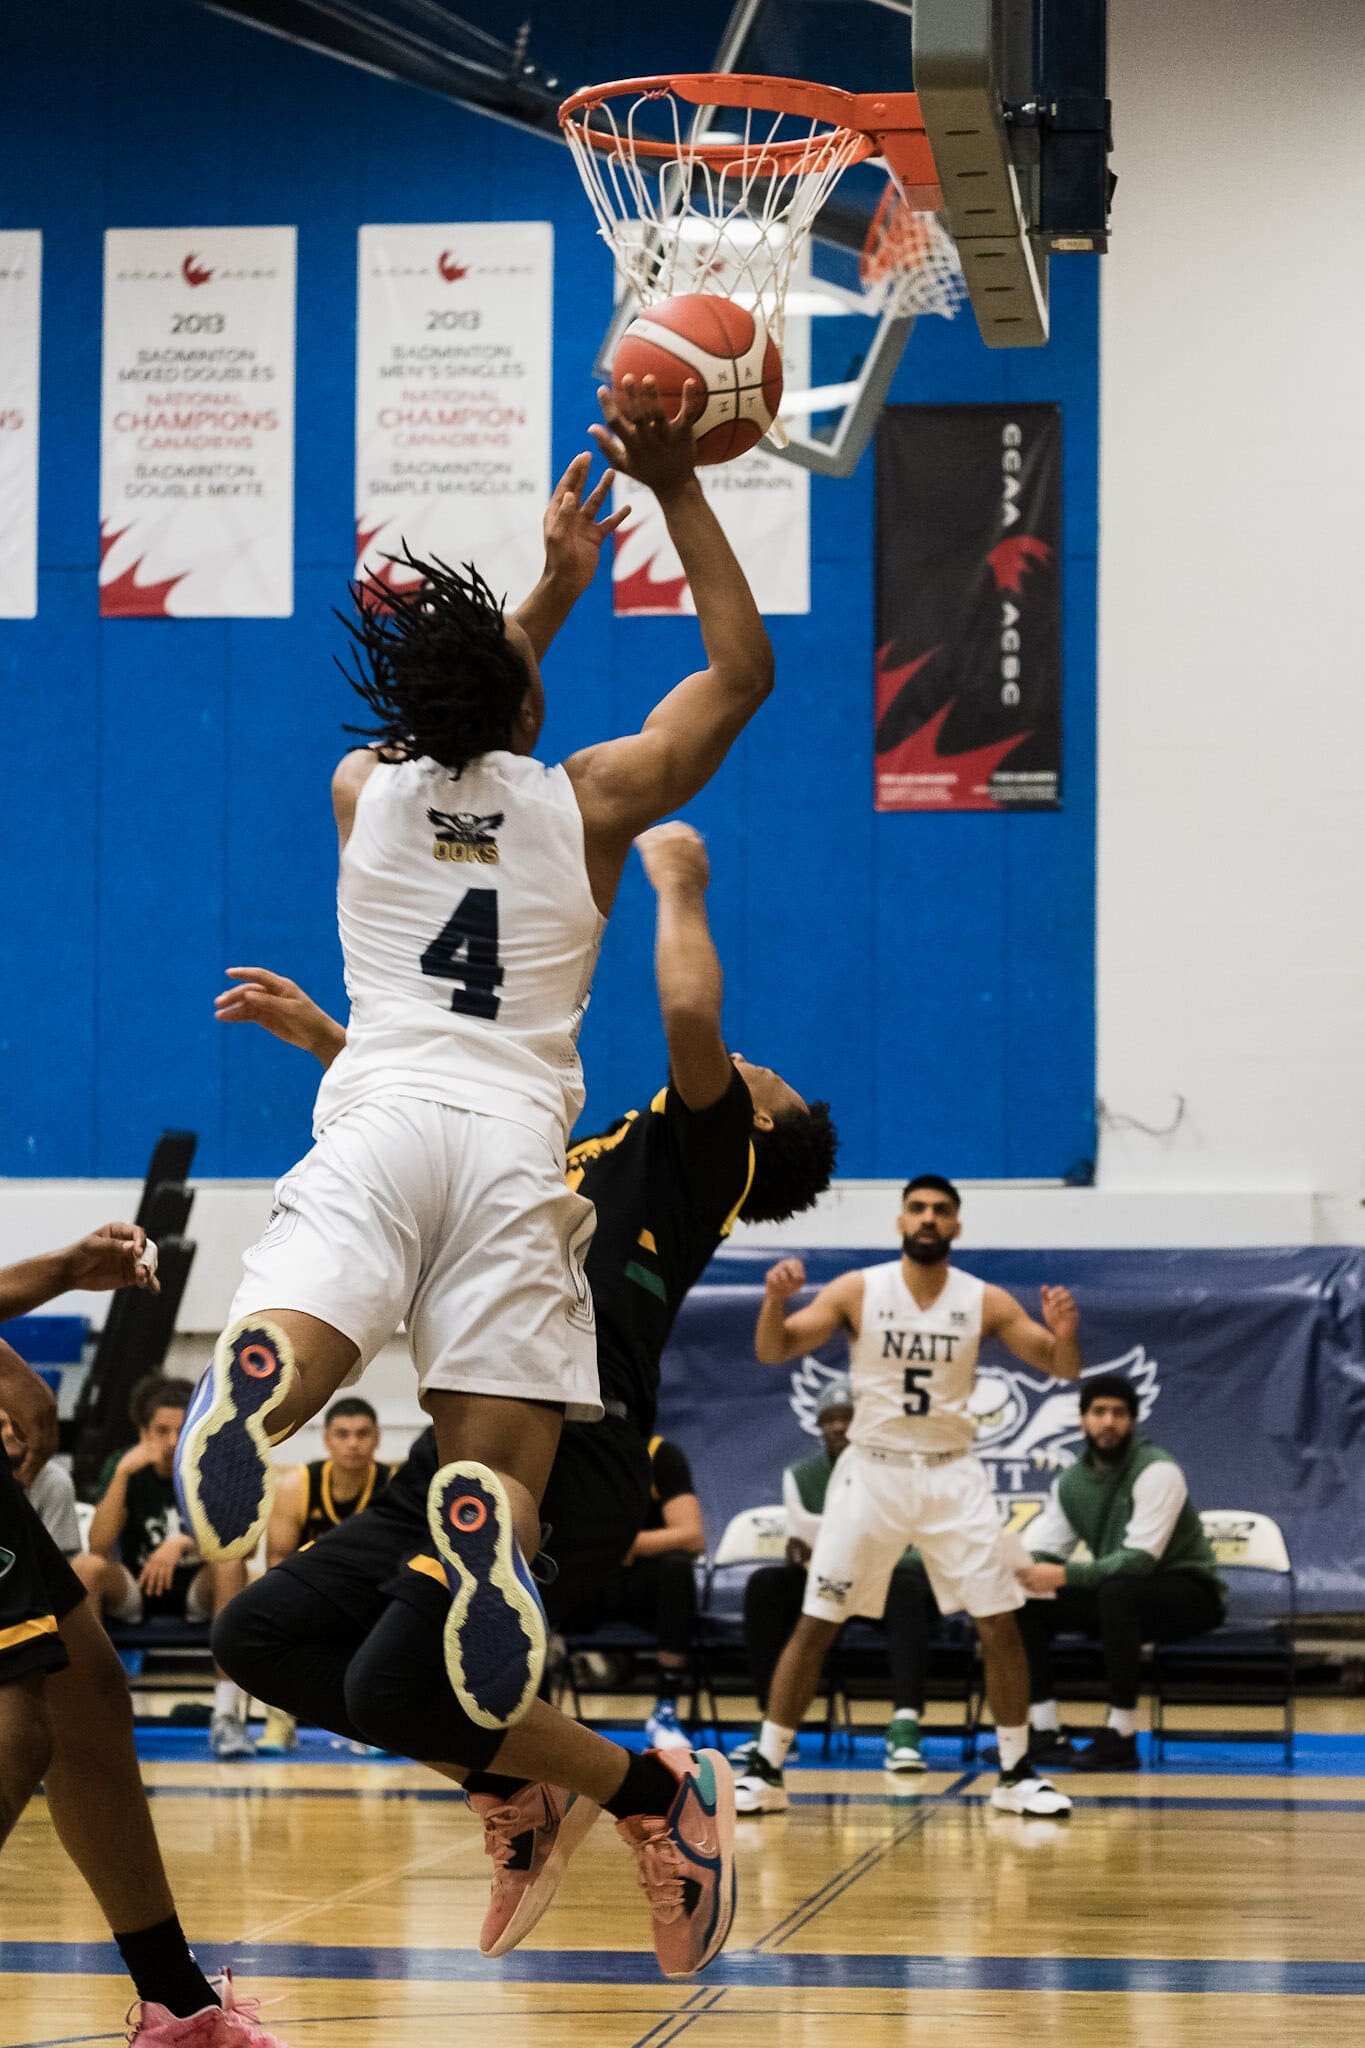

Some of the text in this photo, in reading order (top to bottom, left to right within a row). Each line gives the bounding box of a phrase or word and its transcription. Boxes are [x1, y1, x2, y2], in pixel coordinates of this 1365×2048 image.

[171, 312, 225, 335] 2013
[426, 309, 481, 331] 2013
[137, 349, 255, 363] BADMINTON
[392, 345, 511, 360] BADMINTON
[118, 366, 274, 382] MIXED DOUBLES
[445, 363, 525, 378] SINGLES
[146, 392, 241, 406] NATIONAL
[402, 390, 498, 402] NATIONAL
[113, 409, 279, 431] CHAMPIONS
[378, 408, 526, 429] CHAMPION
[137, 436, 253, 450] CANADIENS
[393, 433, 510, 447] CANADIENS
[135, 464, 255, 479] BADMINTON
[392, 461, 511, 475] BADMINTON
[1001, 423, 1021, 527] CCAA
[125, 483, 263, 498] DOUBLE MIXTE
[368, 480, 536, 496] SIMPLE MASCULIN
[433, 840, 500, 864] OOKS
[420, 887, 504, 1021] 4
[882, 1330, 960, 1363] NAIT
[903, 1367, 933, 1416] 5
